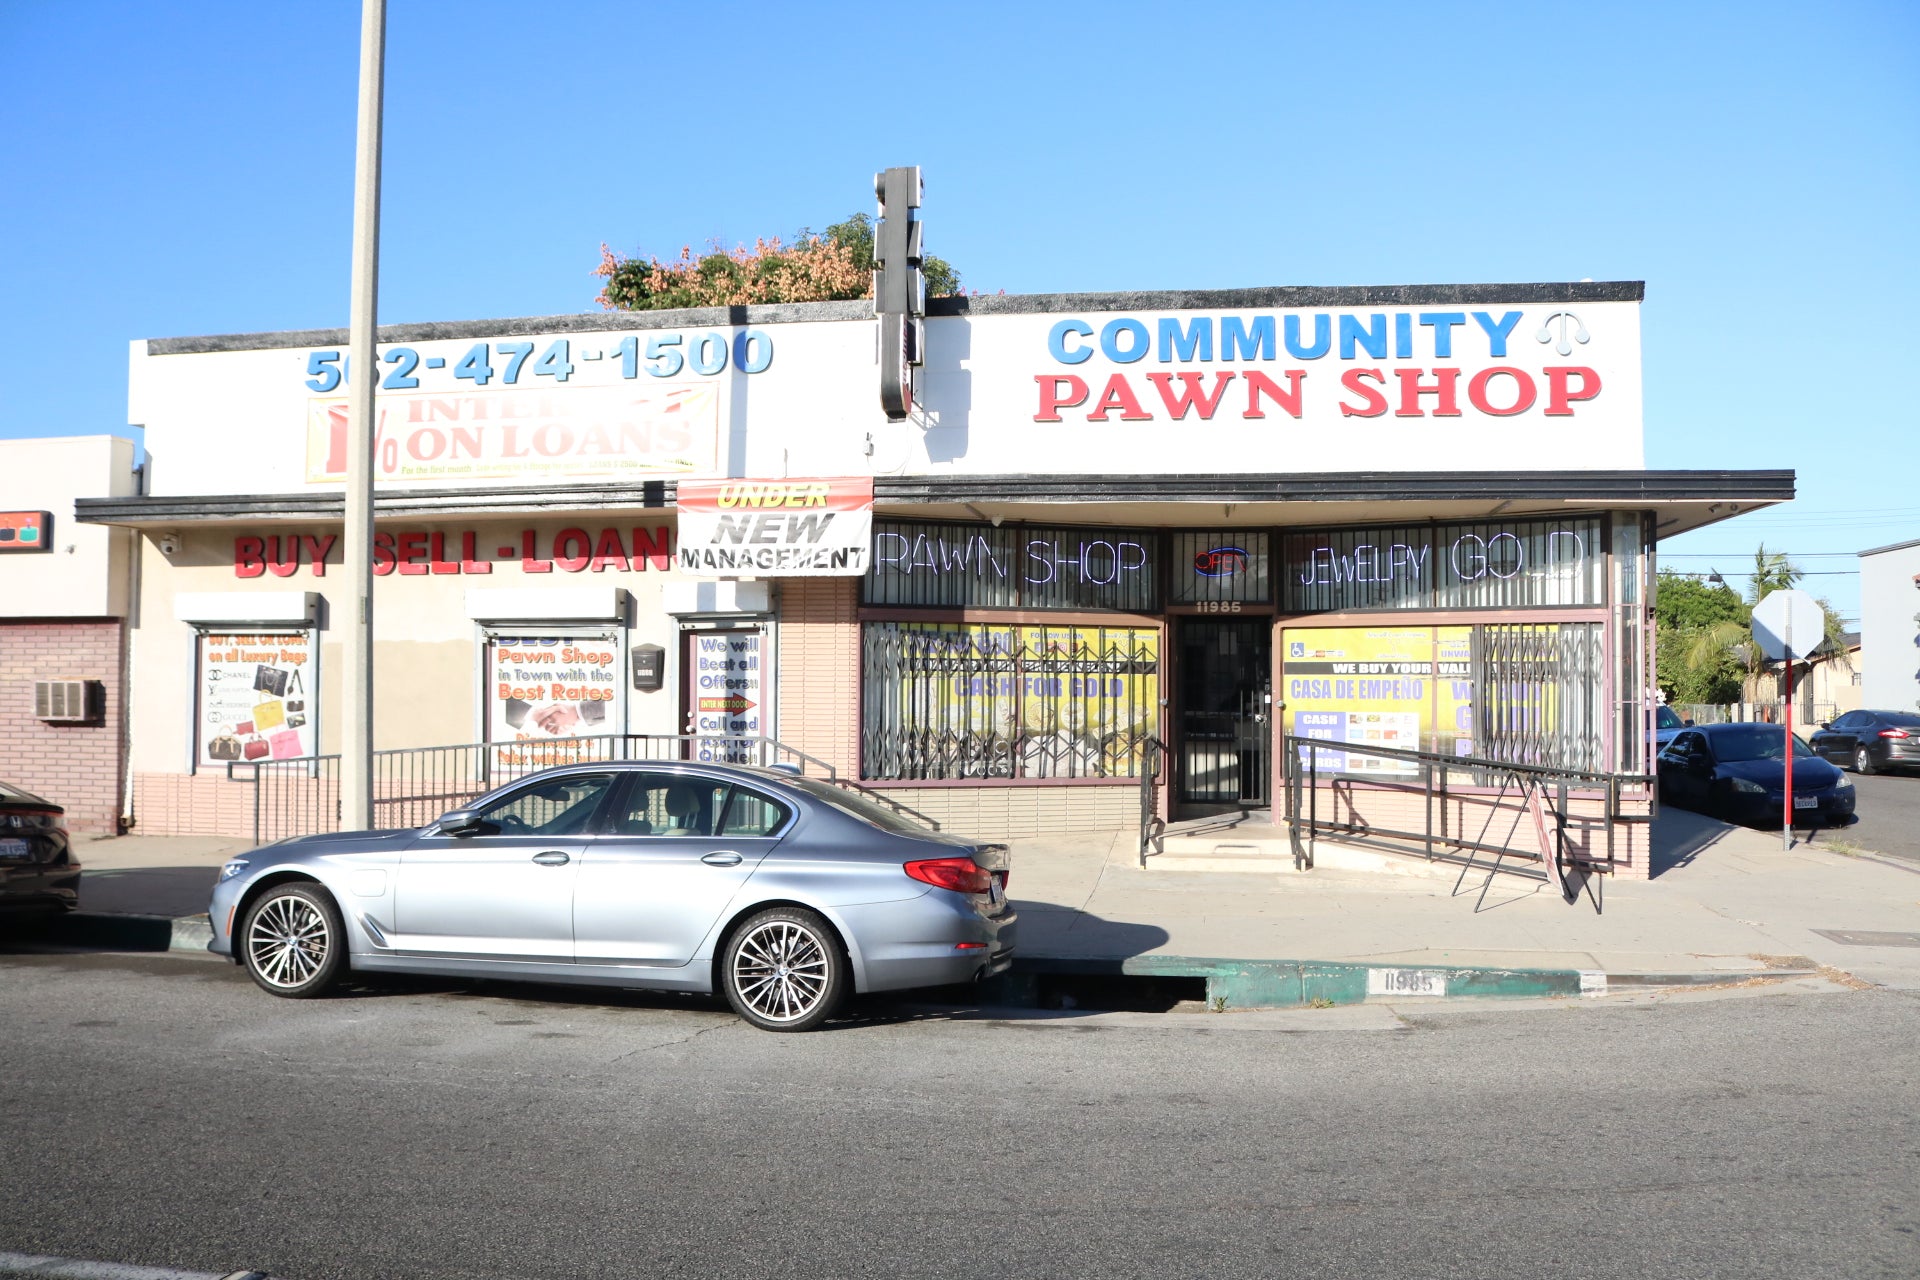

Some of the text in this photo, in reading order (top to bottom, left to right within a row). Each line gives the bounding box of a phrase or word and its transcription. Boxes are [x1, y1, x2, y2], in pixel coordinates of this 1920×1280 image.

[1048, 311, 1524, 364] COMMUNITY
[305, 329, 774, 393] 52-474-1500
[1034, 366, 1603, 422] PAWN SHOP
[407, 419, 695, 462] ON LOANS
[401, 465, 414, 475] For
[416, 464, 428, 474] the
[430, 463, 445, 474] first
[447, 464, 472, 473] month
[717, 483, 831, 509] UNDER
[710, 513, 836, 545] NEW
[234, 534, 336, 578] BUY
[522, 526, 678, 573] LOAN
[680, 547, 866, 570] MANAGEMENT
[877, 533, 1147, 585] PAWN SHOP
[1452, 532, 1584, 580] GOD
[1197, 601, 1241, 613] 11985
[700, 638, 759, 652] We will
[209, 648, 307, 666] on all Luxury Bags
[498, 647, 614, 668] Pawn Shop
[700, 656, 759, 671] Beat all
[498, 669, 614, 681] in Town with the
[1333, 664, 1356, 674] WE
[1358, 664, 1389, 674] BUY
[1391, 664, 1432, 674] YOUR
[498, 683, 615, 701] Best Rates
[955, 678, 1123, 698] CASH FOR GOLD
[1290, 676, 1423, 700] CASA DE EMPEÑO
[732, 700, 748, 708] DOOR
[700, 716, 759, 732] Call and
[1303, 714, 1338, 724] CASH
[1308, 728, 1332, 739] FOR
